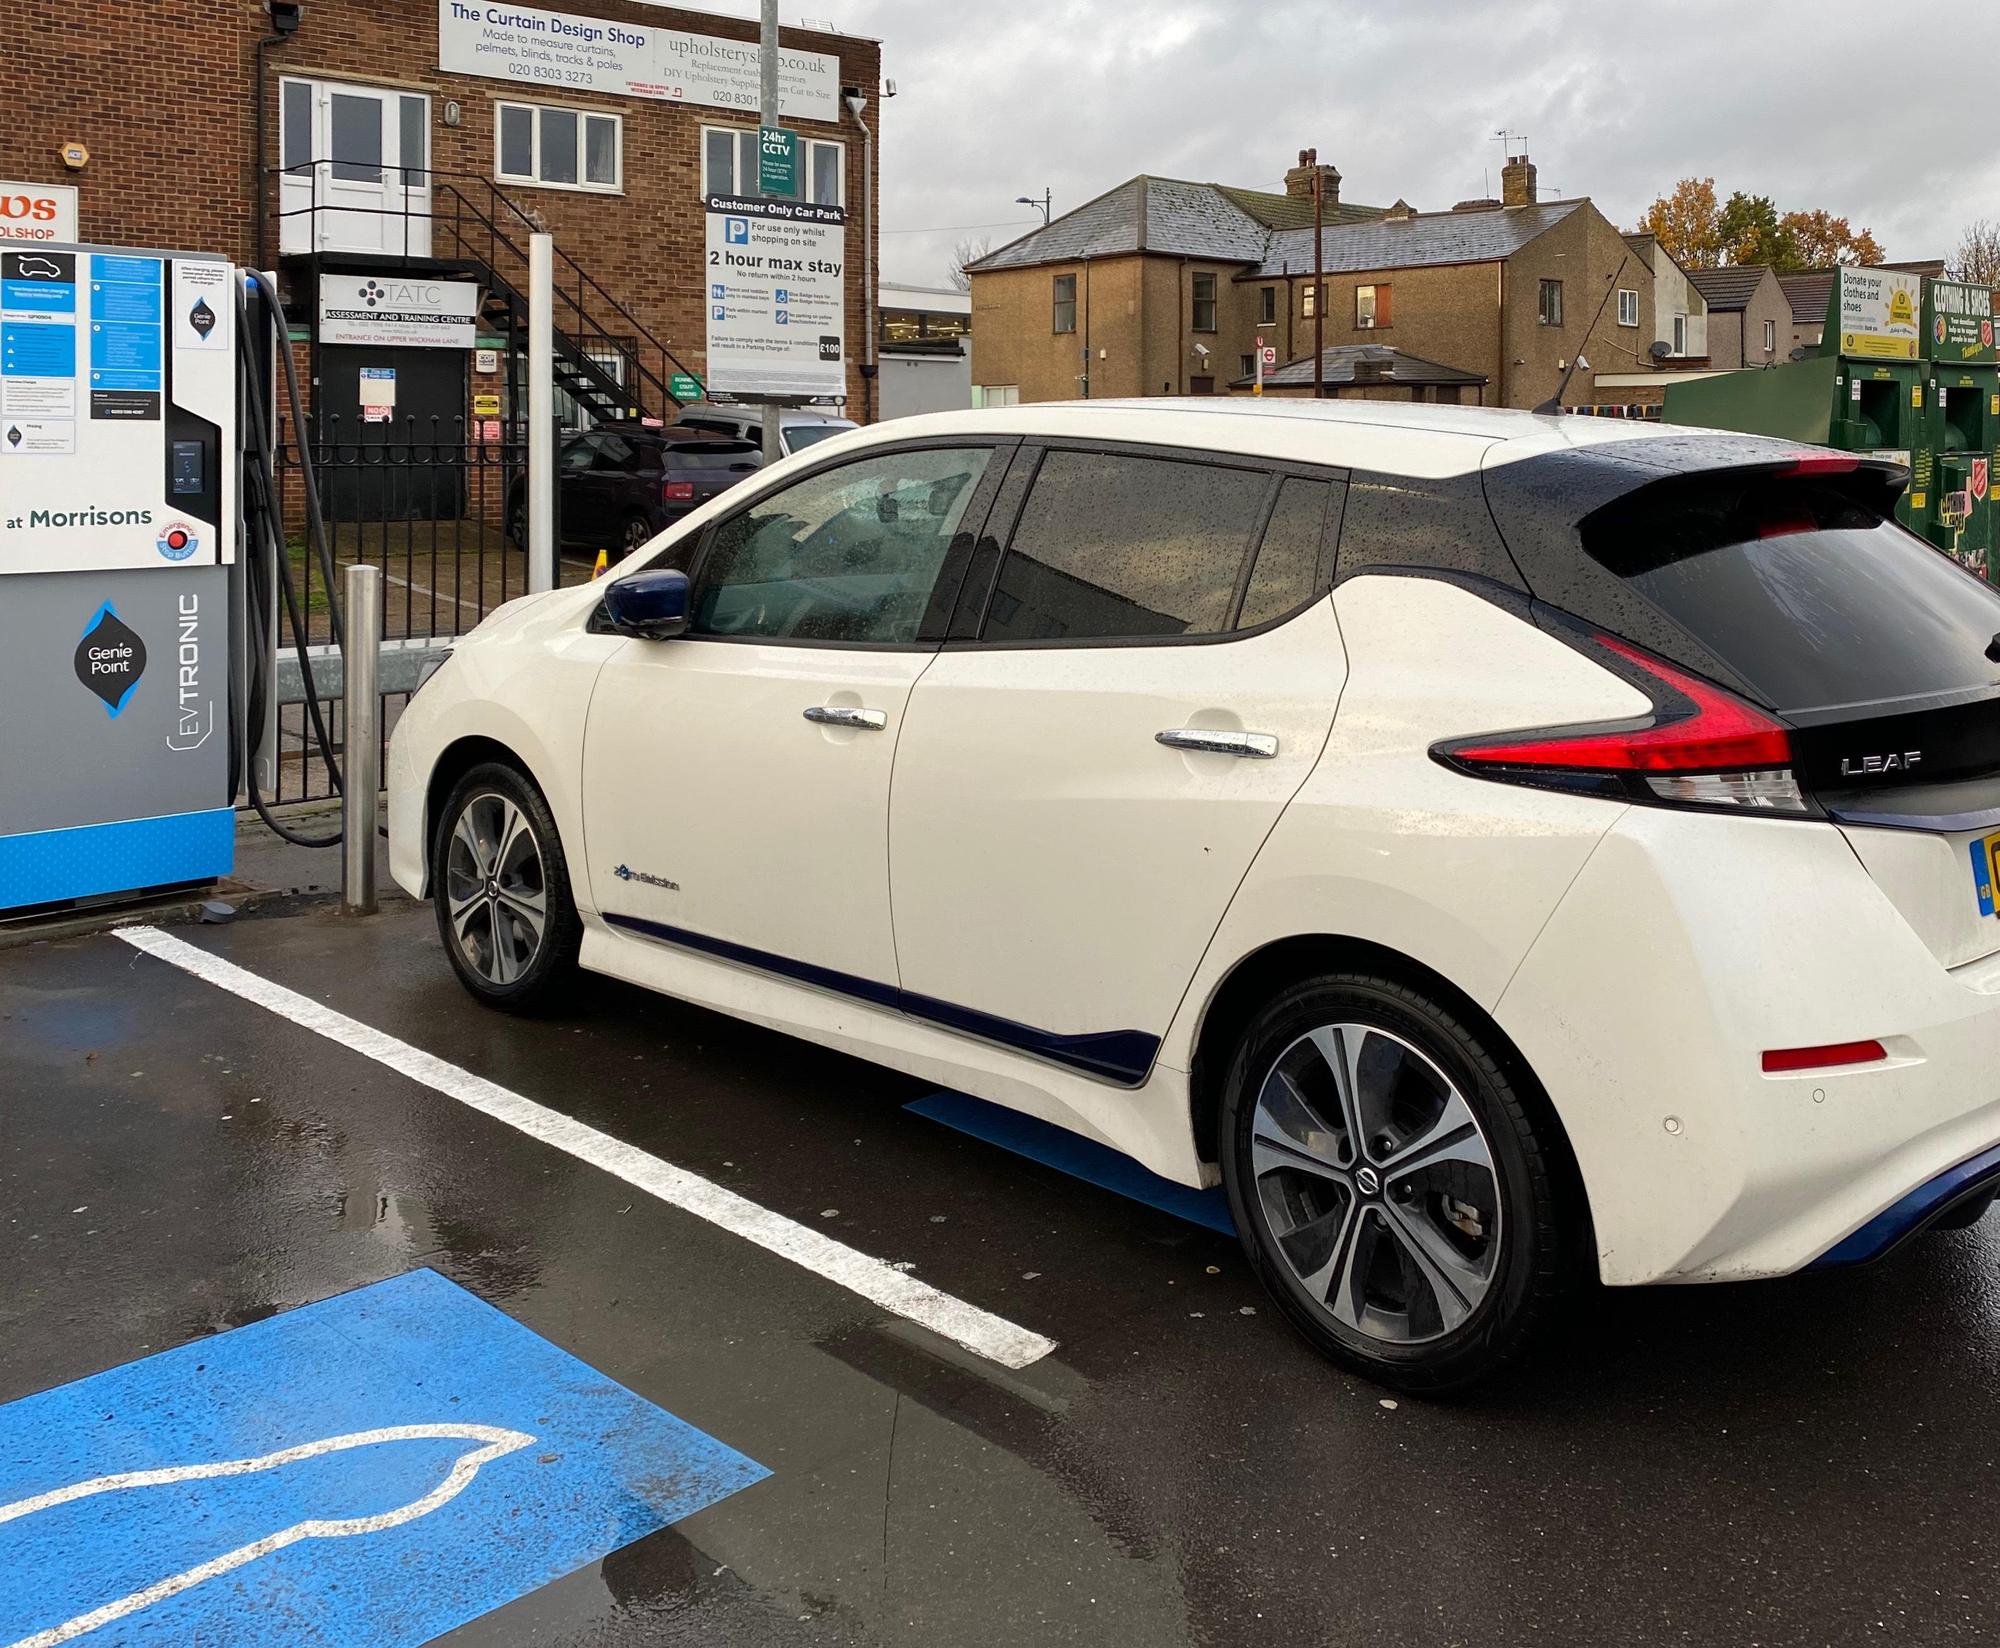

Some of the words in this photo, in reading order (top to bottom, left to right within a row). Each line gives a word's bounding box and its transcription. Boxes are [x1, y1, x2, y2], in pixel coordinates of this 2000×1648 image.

[450, 3, 480, 21] The
[486, 9, 546, 31] Curtain
[551, 19, 602, 42] Design
[608, 28, 645, 48] Shop
[482, 28, 514, 42] Made
[517, 34, 527, 44] to
[531, 37, 573, 50] measure
[576, 44, 616, 58] curtains,
[476, 42, 518, 57] pelmets,
[521, 48, 553, 62] blinds,
[556, 53, 583, 65] tracks
[586, 57, 594, 66] &
[597, 59, 623, 71] poles
[669, 38, 826, 74] upholsterysp.co.uk
[509, 63, 530, 75] 020
[534, 66, 562, 79] 8303
[565, 70, 593, 84] 3273
[691, 60, 741, 75] Replacement
[778, 74, 806, 84] nteriors
[664, 68, 682, 77] DIY
[685, 71, 728, 85] Upholstery
[790, 86, 804, 96] Cut
[816, 90, 830, 99] Size
[713, 90, 731, 102] 020
[735, 93, 758, 105] 8301
[762, 131, 786, 143] 24hr
[762, 143, 790, 156] CCTV
[711, 198, 765, 212] Customer
[768, 204, 792, 217] Only
[795, 207, 814, 217] Car
[817, 209, 840, 220] Park
[752, 222, 765, 230] For
[784, 225, 800, 236] only
[802, 228, 825, 236] whilst
[752, 234, 788, 246] shopping
[803, 238, 816, 247] site
[710, 251, 720, 265] 2
[725, 251, 763, 268] hour
[768, 259, 803, 271] max
[808, 259, 842, 277] stay
[770, 272, 790, 280] within
[1844, 273, 1866, 286] Donate
[1868, 279, 1882, 289] your
[384, 284, 441, 304] TATC
[1844, 287, 1866, 299] clothes
[1867, 290, 1879, 300] and
[1934, 284, 1964, 314] CLOTHING
[1965, 288, 1970, 315] &
[1971, 289, 1990, 317] SHOES
[1844, 300, 1862, 312] shoes
[326, 310, 378, 320] ASSESSMENT
[400, 314, 439, 323] TRAINING
[820, 344, 840, 353] £100
[7, 516, 23, 528] at
[30, 505, 152, 528] Morrisons
[159, 521, 195, 538] Emergency
[159, 542, 173, 558] Stop
[175, 541, 196, 559] Button
[88, 642, 132, 660] Genie
[92, 660, 130, 674] Point
[179, 594, 198, 735] EVTRONIC
[1841, 751, 1921, 776] LEAF
[1981, 884, 1991, 899] GB
